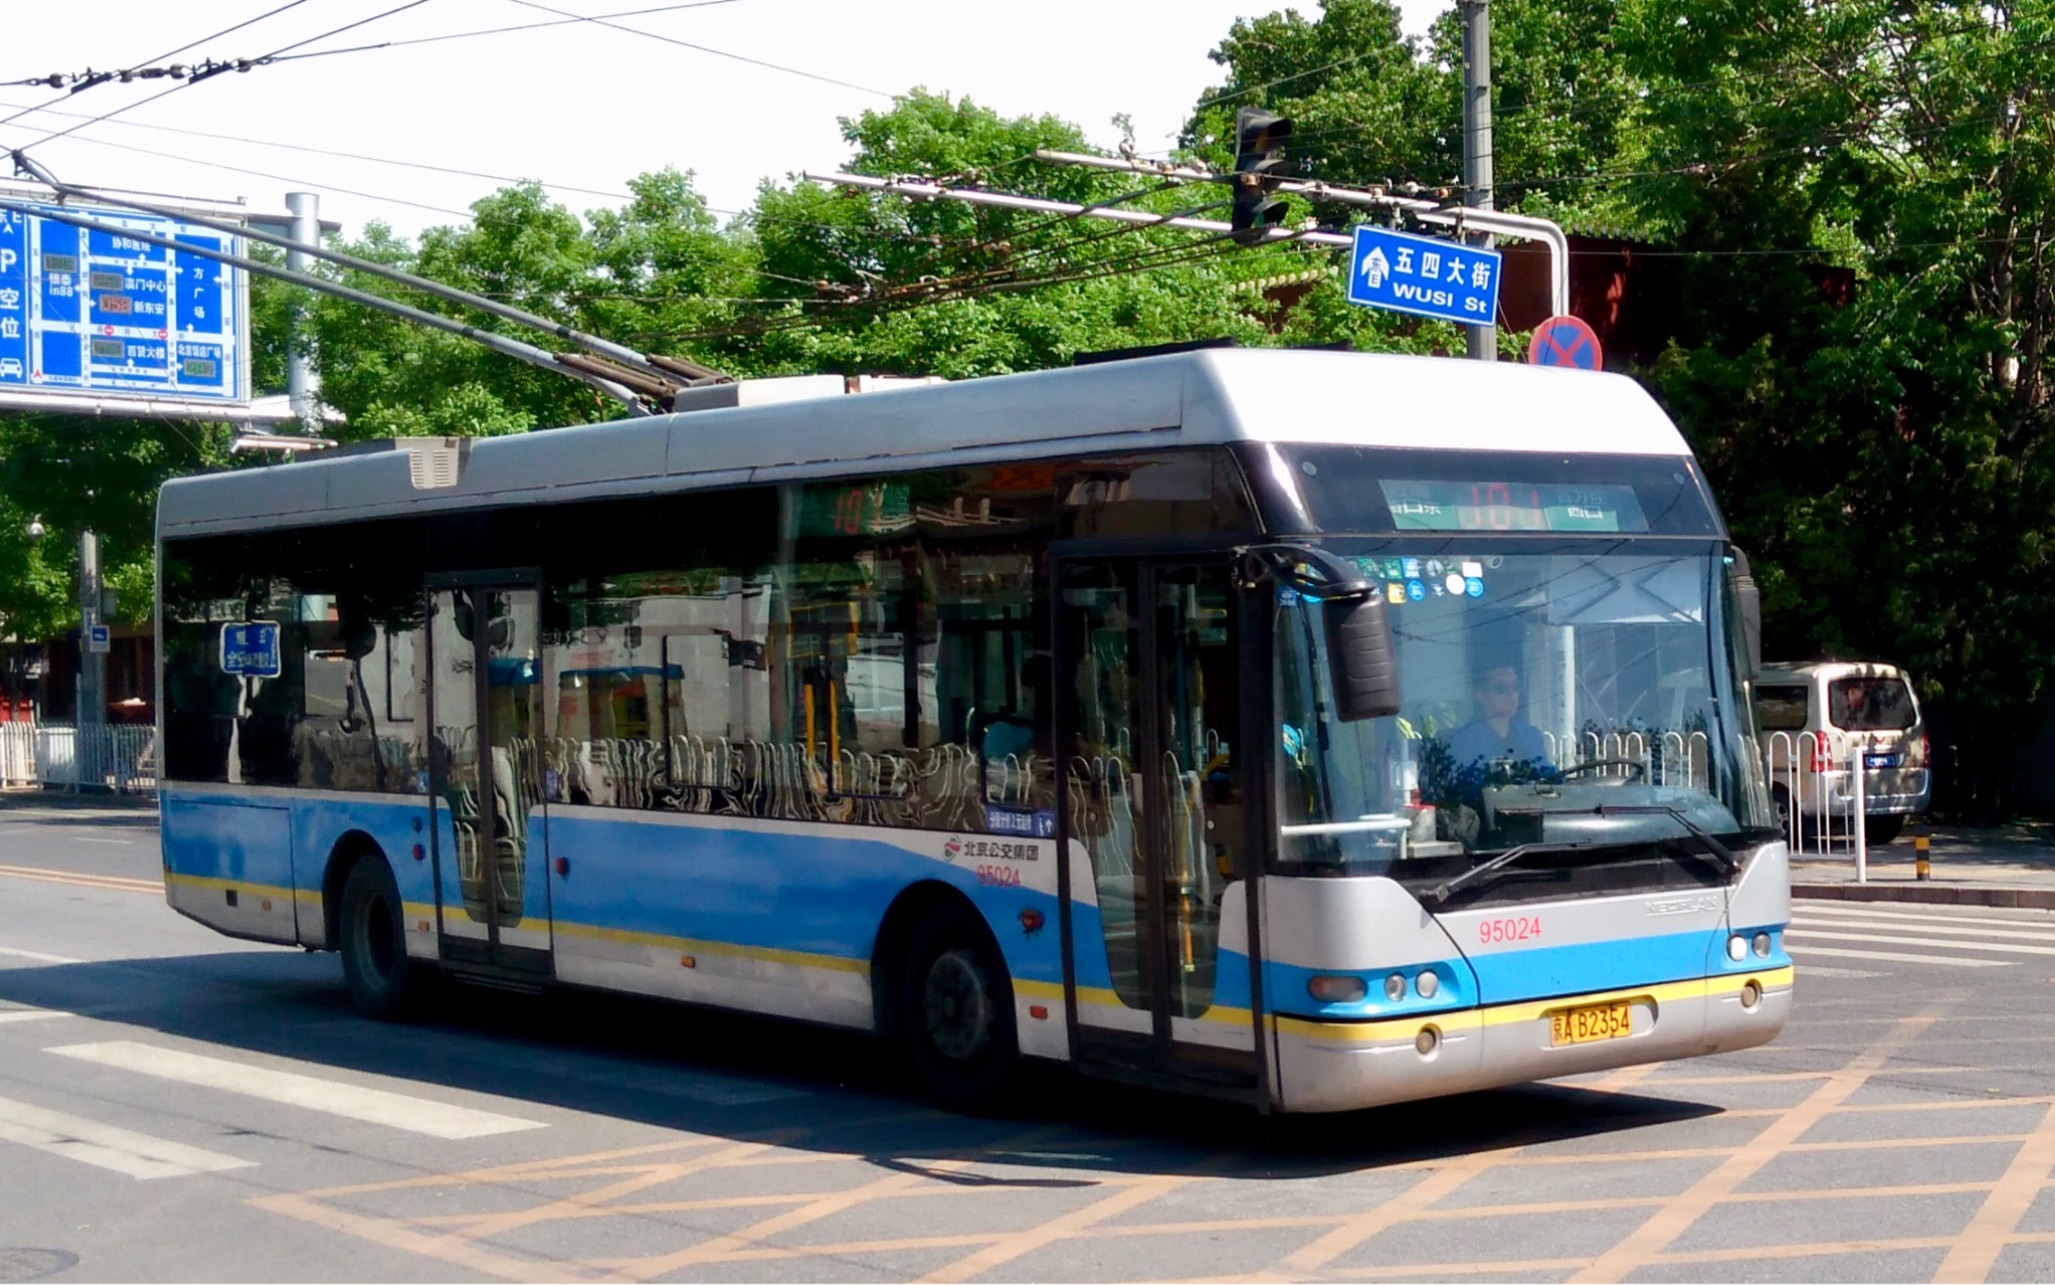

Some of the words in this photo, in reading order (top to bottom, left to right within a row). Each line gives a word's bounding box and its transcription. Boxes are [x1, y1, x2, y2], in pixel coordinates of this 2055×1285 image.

[1, 248, 17, 274] P
[1394, 247, 1491, 289] 五四大街
[125, 278, 166, 293] 澳门中心
[193, 255, 206, 319] 方广场
[1371, 274, 1379, 285] E
[49, 286, 74, 298] in88
[1393, 282, 1453, 307] WUSI
[1464, 295, 1488, 314] St
[0, 287, 20, 338] 空位
[134, 301, 165, 316] 新东安
[127, 345, 165, 360] 百货大楼
[964, 842, 1038, 860] 北京公交集团
[977, 864, 1021, 888] 95024
[1479, 916, 1542, 944] 95024
